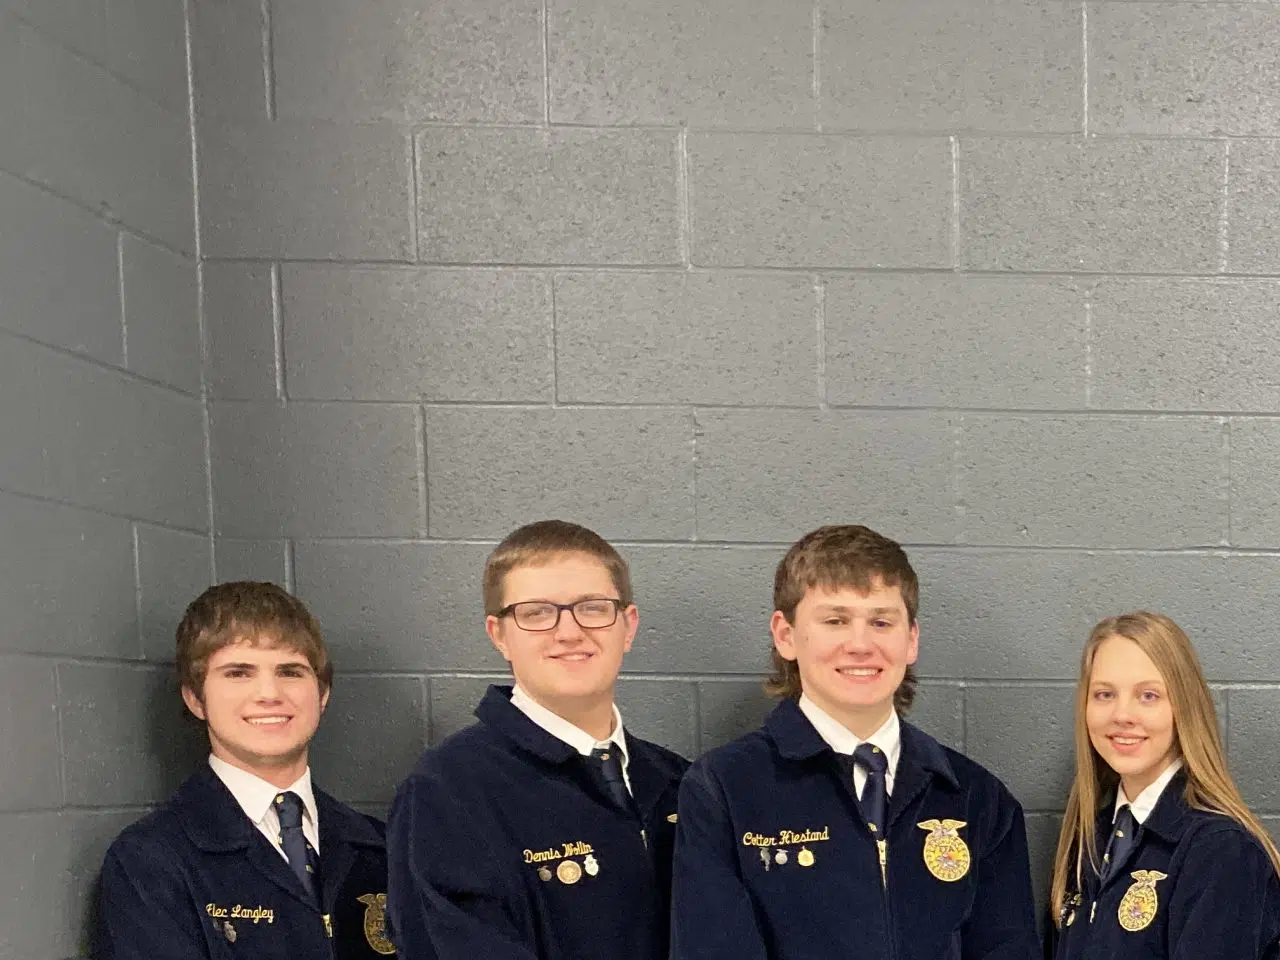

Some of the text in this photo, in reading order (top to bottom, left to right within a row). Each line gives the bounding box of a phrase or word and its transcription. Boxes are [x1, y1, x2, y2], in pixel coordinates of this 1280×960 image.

[779, 825, 830, 845] Hiestand
[523, 848, 562, 863] Dennis
[231, 904, 275, 923] Langley
